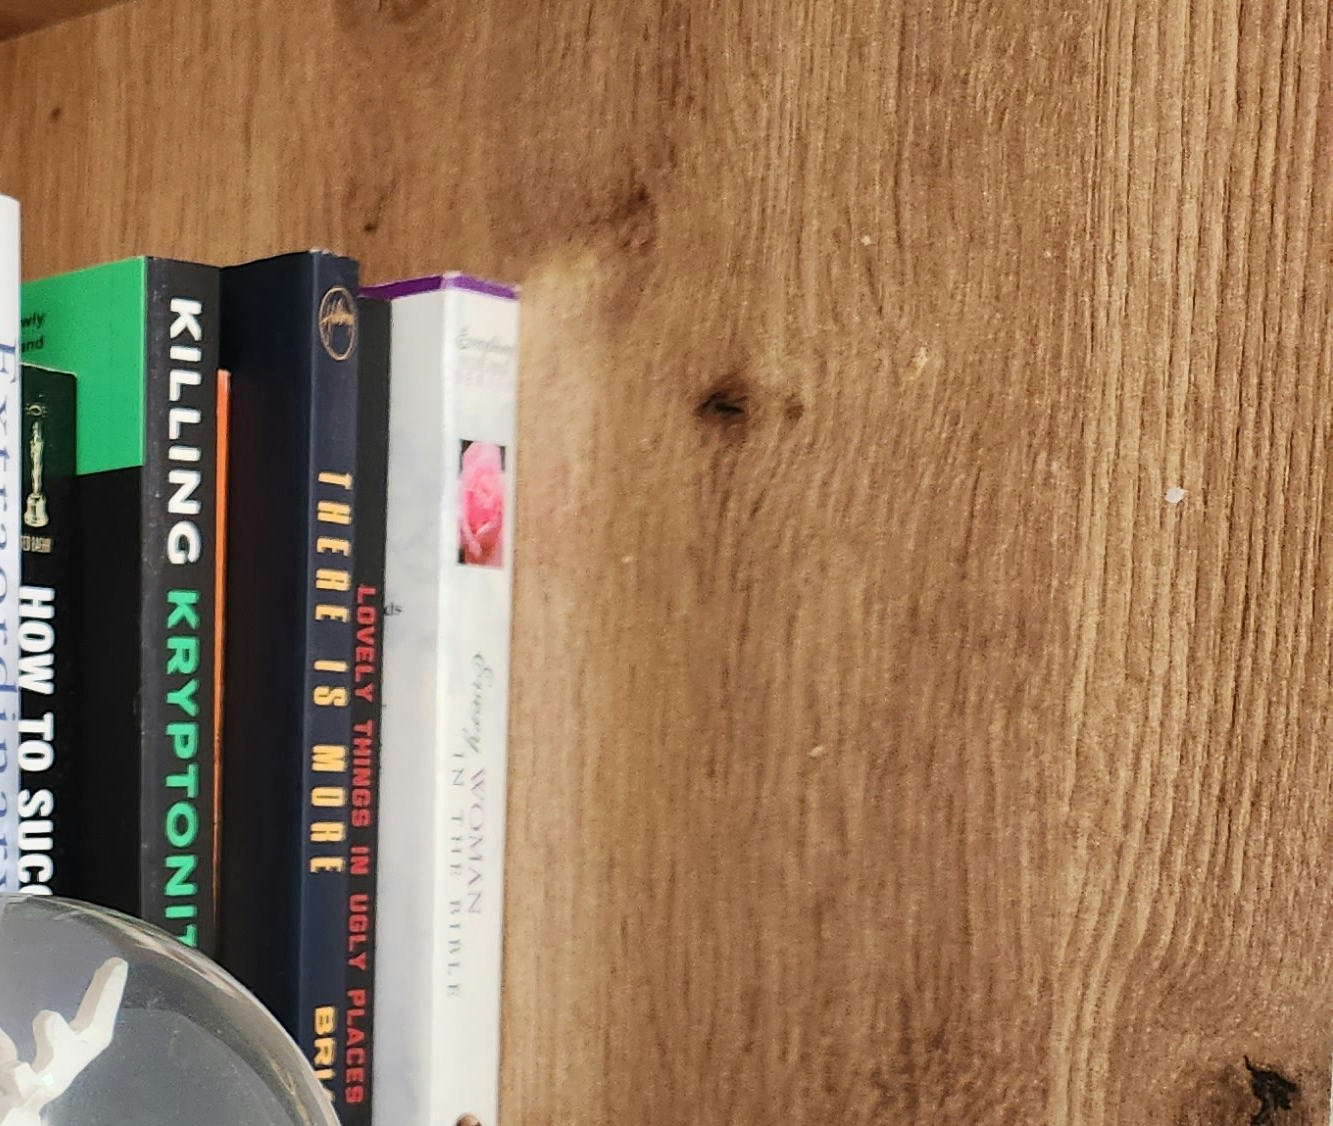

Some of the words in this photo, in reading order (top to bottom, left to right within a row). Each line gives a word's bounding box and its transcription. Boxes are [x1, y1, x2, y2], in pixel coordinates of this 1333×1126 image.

[167, 298, 203, 565] KILLING
[314, 471, 353, 624] THERE
[17, 585, 56, 695] HOW
[312, 658, 349, 708] IS
[355, 584, 377, 703] LOVELY
[17, 712, 55, 772] TO
[351, 719, 374, 828] THINGS
[451, 752, 465, 787] IN
[17, 788, 55, 896] SUC
[309, 743, 348, 875] MORE
[350, 845, 371, 876] IN
[449, 810, 465, 877] THE
[467, 766, 485, 917] WOMAN
[348, 894, 370, 972] UGLY
[345, 988, 367, 1105] PLACES
